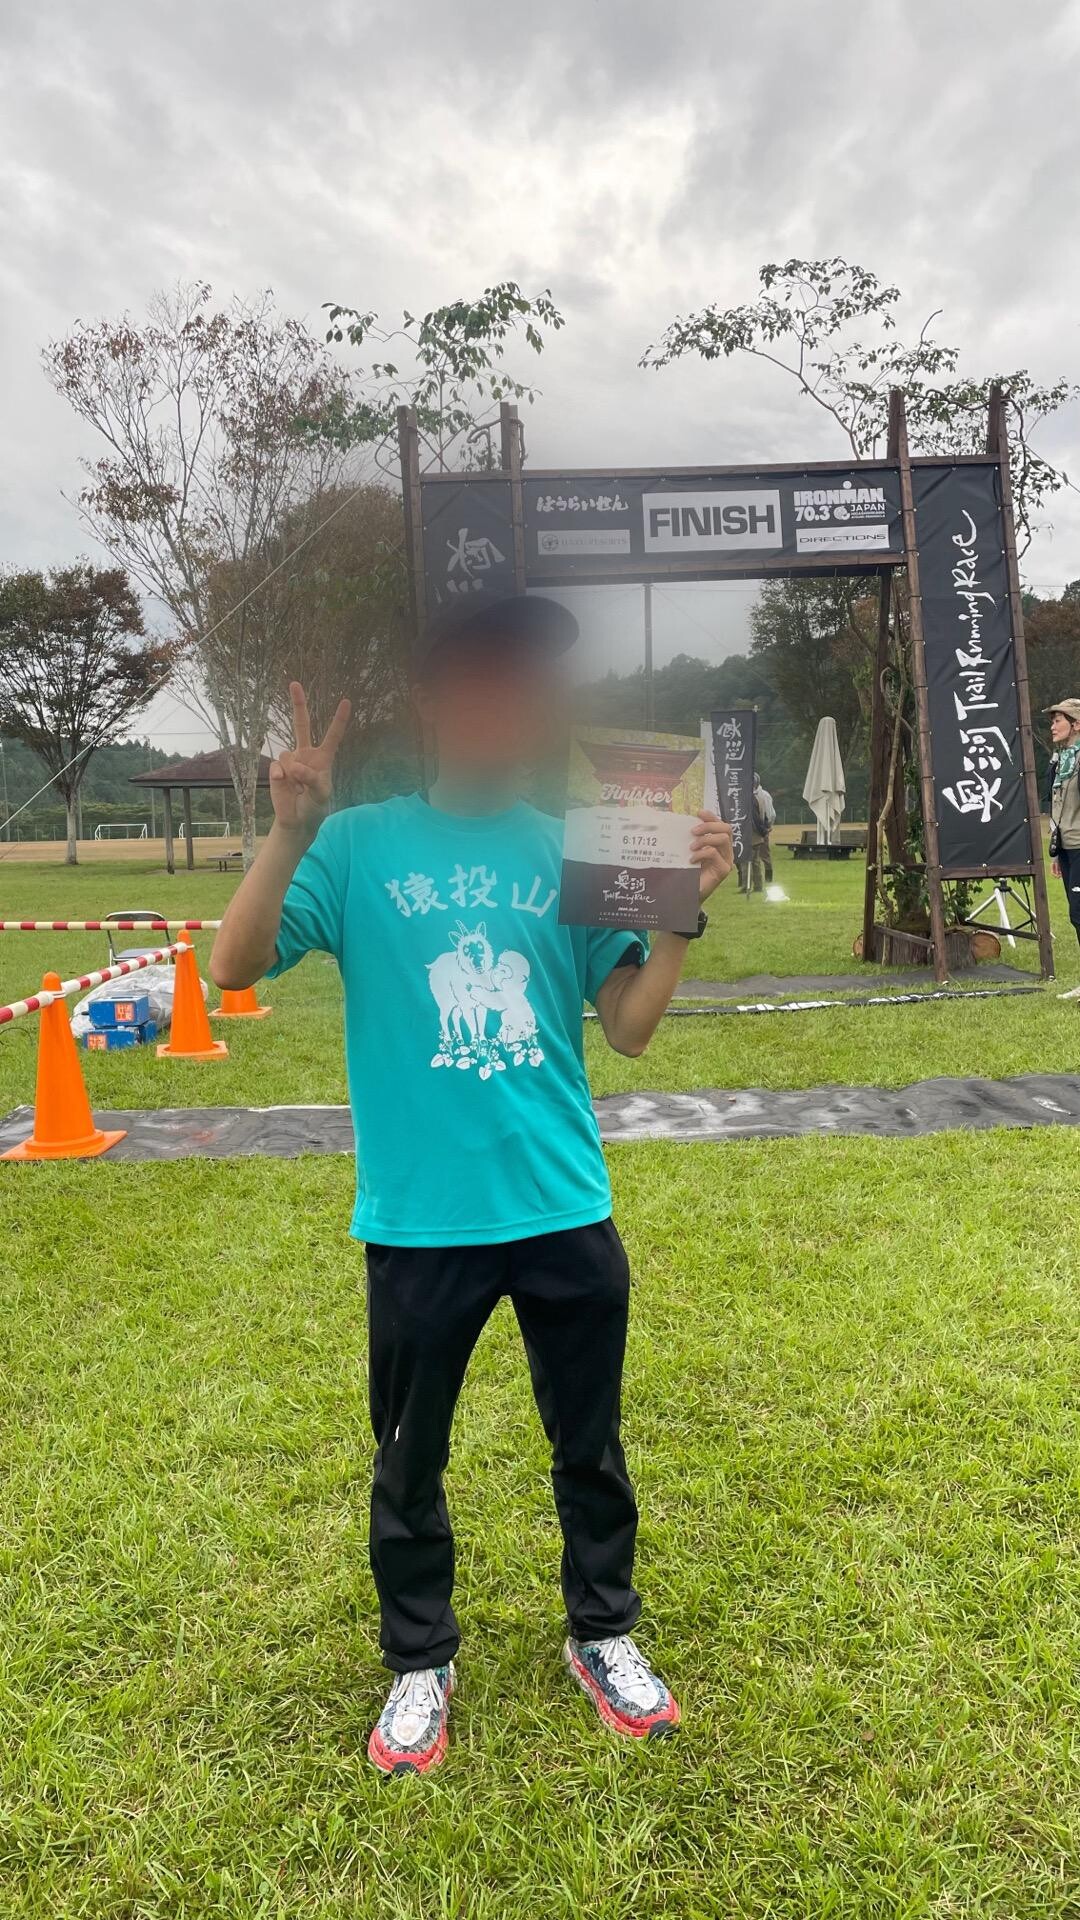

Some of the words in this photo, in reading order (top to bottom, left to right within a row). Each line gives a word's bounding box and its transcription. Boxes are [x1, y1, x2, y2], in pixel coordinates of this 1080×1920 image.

[794, 483, 886, 506] IRONMAN
[649, 504, 776, 538] FINISH
[795, 505, 830, 522] 70.3
[850, 502, 886, 512] JAPAN
[799, 533, 887, 544] DIRECTIONS
[952, 509, 982, 588] Race
[955, 590, 998, 668] Running
[953, 671, 999, 720] Trail
[942, 726, 1013, 823] 奥河
[600, 783, 673, 804] Finisher
[622, 835, 657, 847] 6:17:12
[385, 863, 558, 918] 猿投山
[614, 869, 646, 894] 奥河
